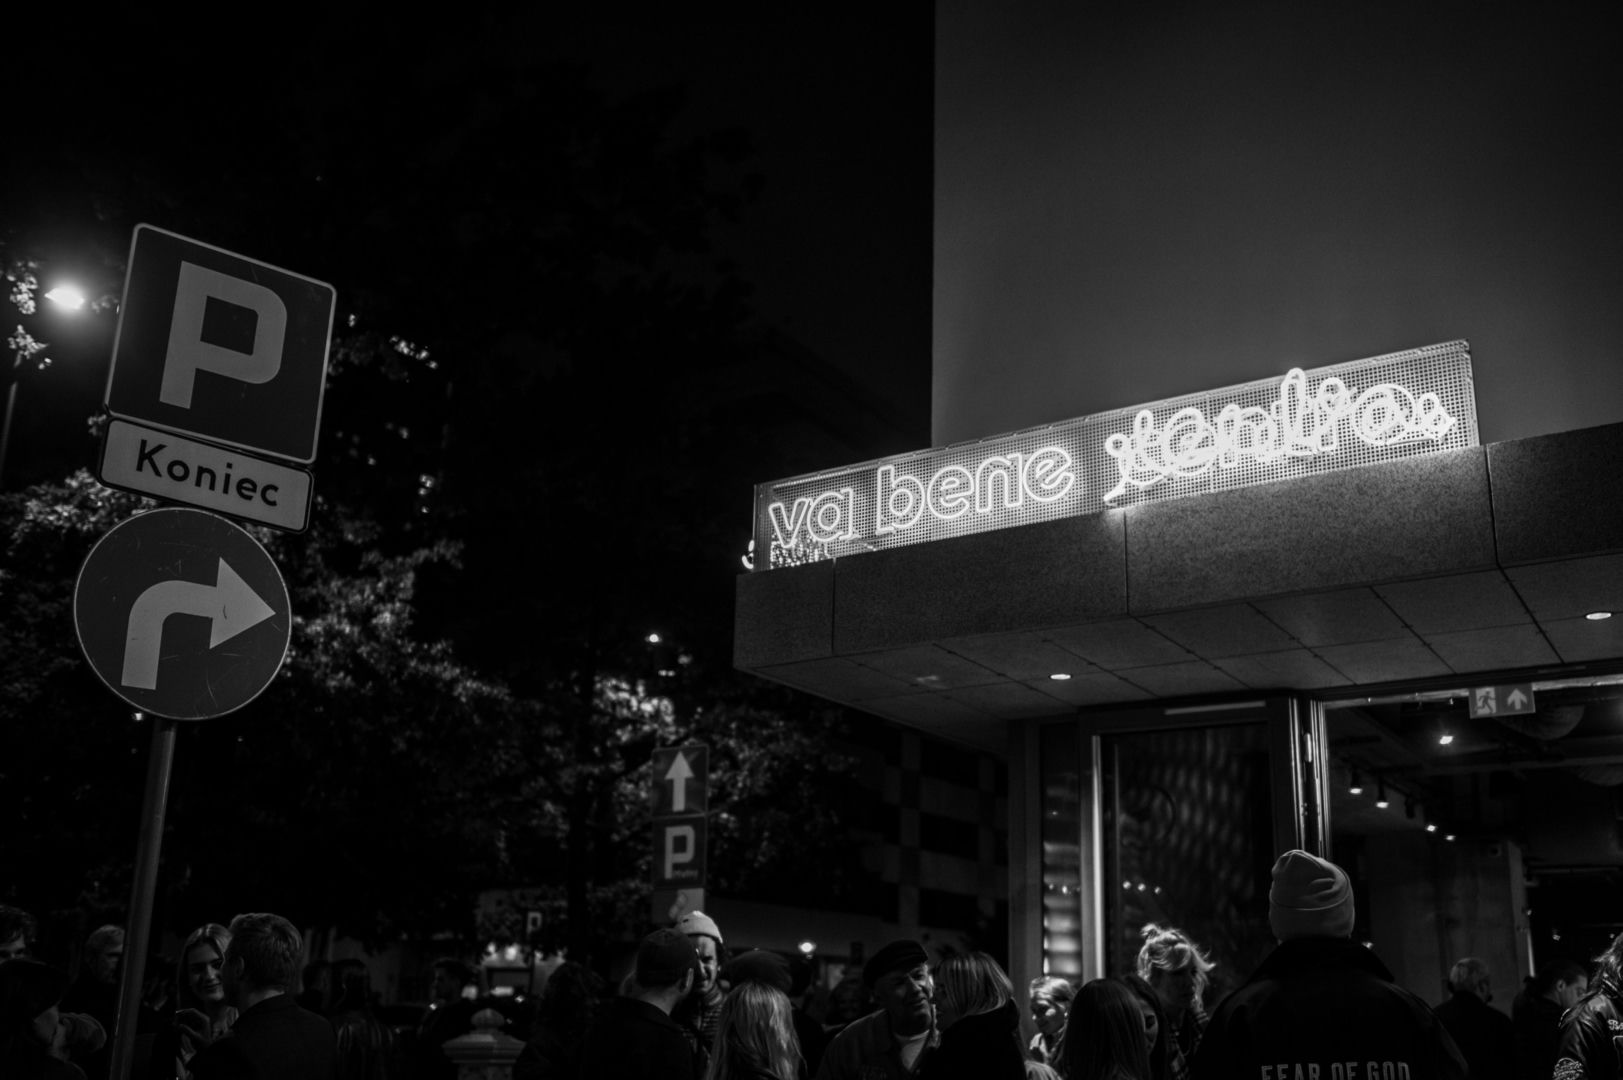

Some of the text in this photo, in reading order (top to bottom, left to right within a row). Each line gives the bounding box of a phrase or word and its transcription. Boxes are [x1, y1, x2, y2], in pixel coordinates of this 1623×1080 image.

[159, 260, 287, 409] P
[136, 439, 279, 507] Koniec
[768, 487, 858, 548] va
[876, 446, 1074, 535] bene
[664, 825, 695, 880] P
[1261, 1060, 1411, 1080] FEAR OF GOD
